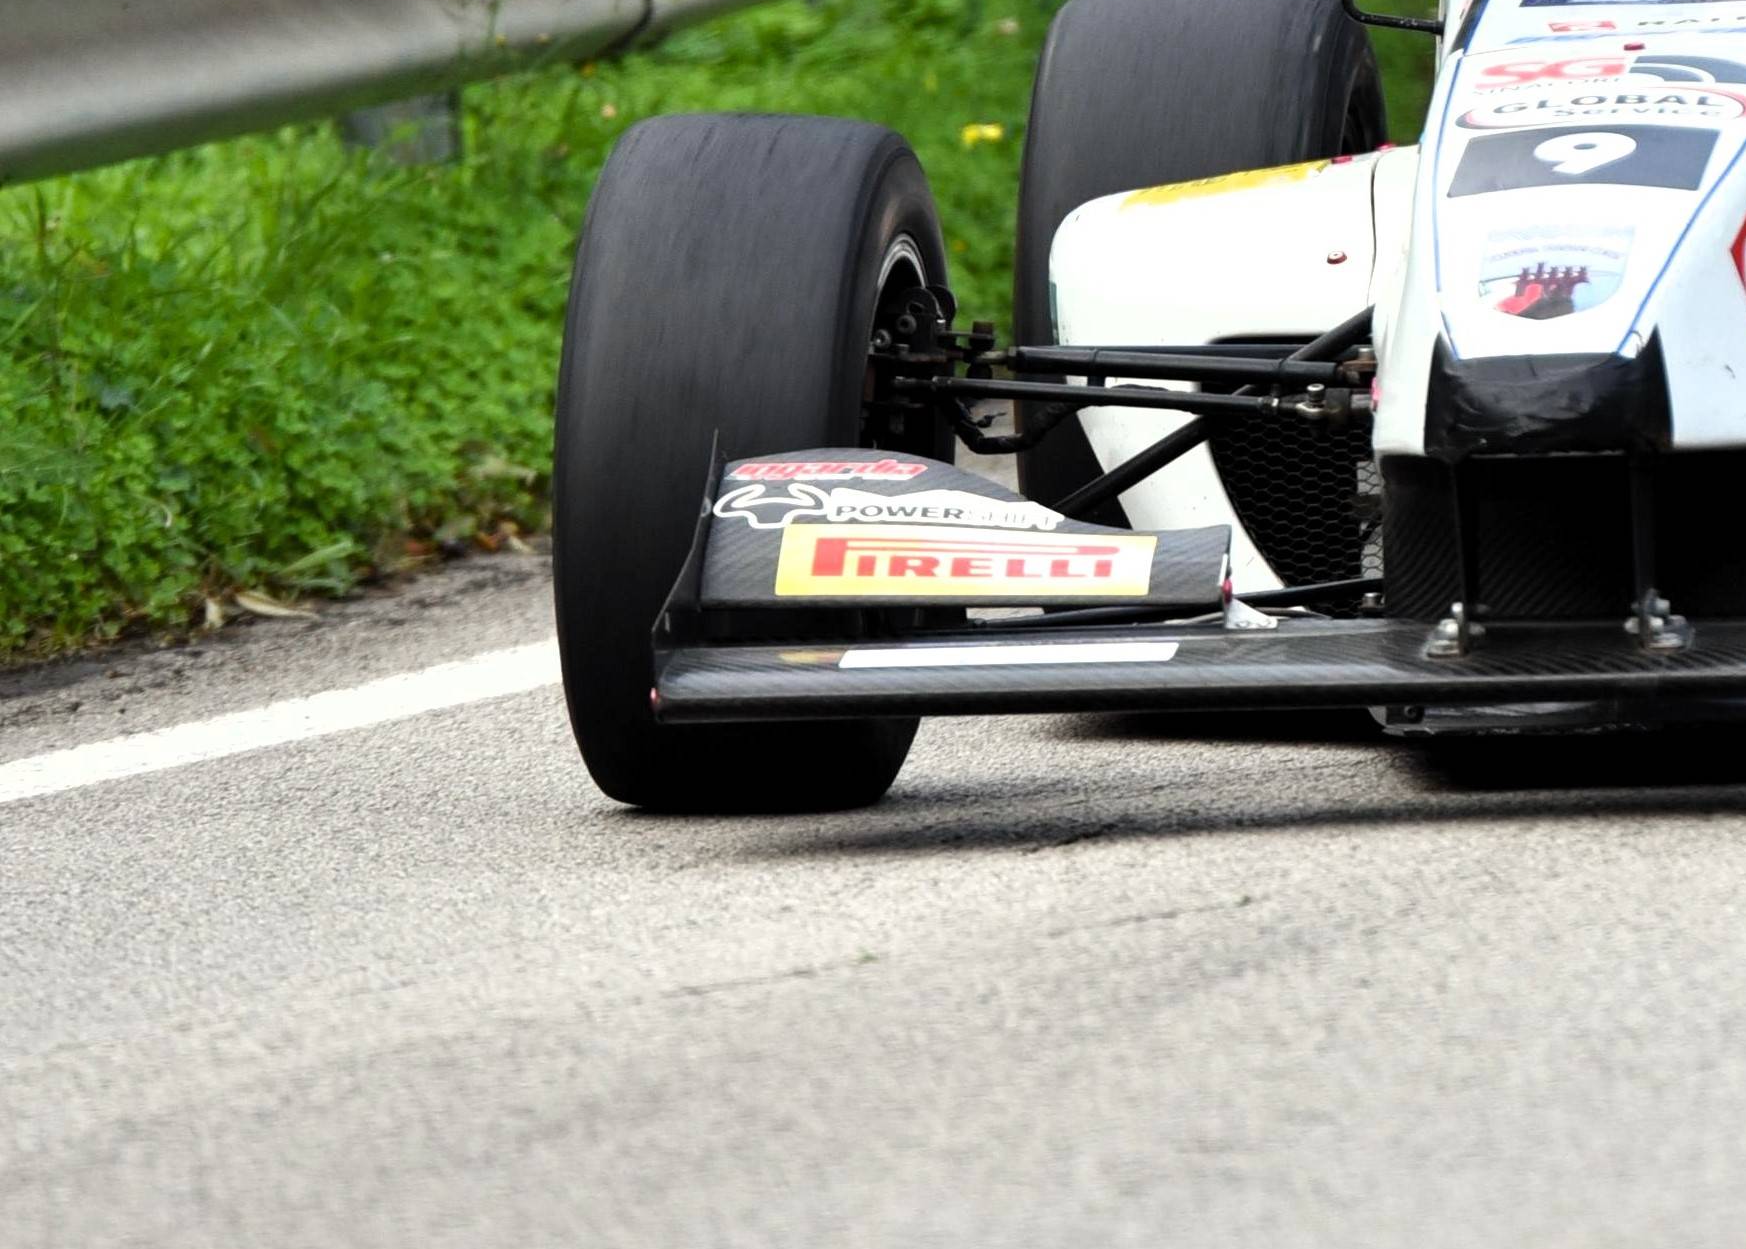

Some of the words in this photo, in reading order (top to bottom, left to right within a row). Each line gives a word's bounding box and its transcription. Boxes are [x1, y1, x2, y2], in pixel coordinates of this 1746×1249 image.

[1474, 55, 1627, 90] SG
[1493, 94, 1724, 115] GLOBAL
[1532, 131, 1638, 175] 9
[811, 537, 1121, 579] PIRELLI
